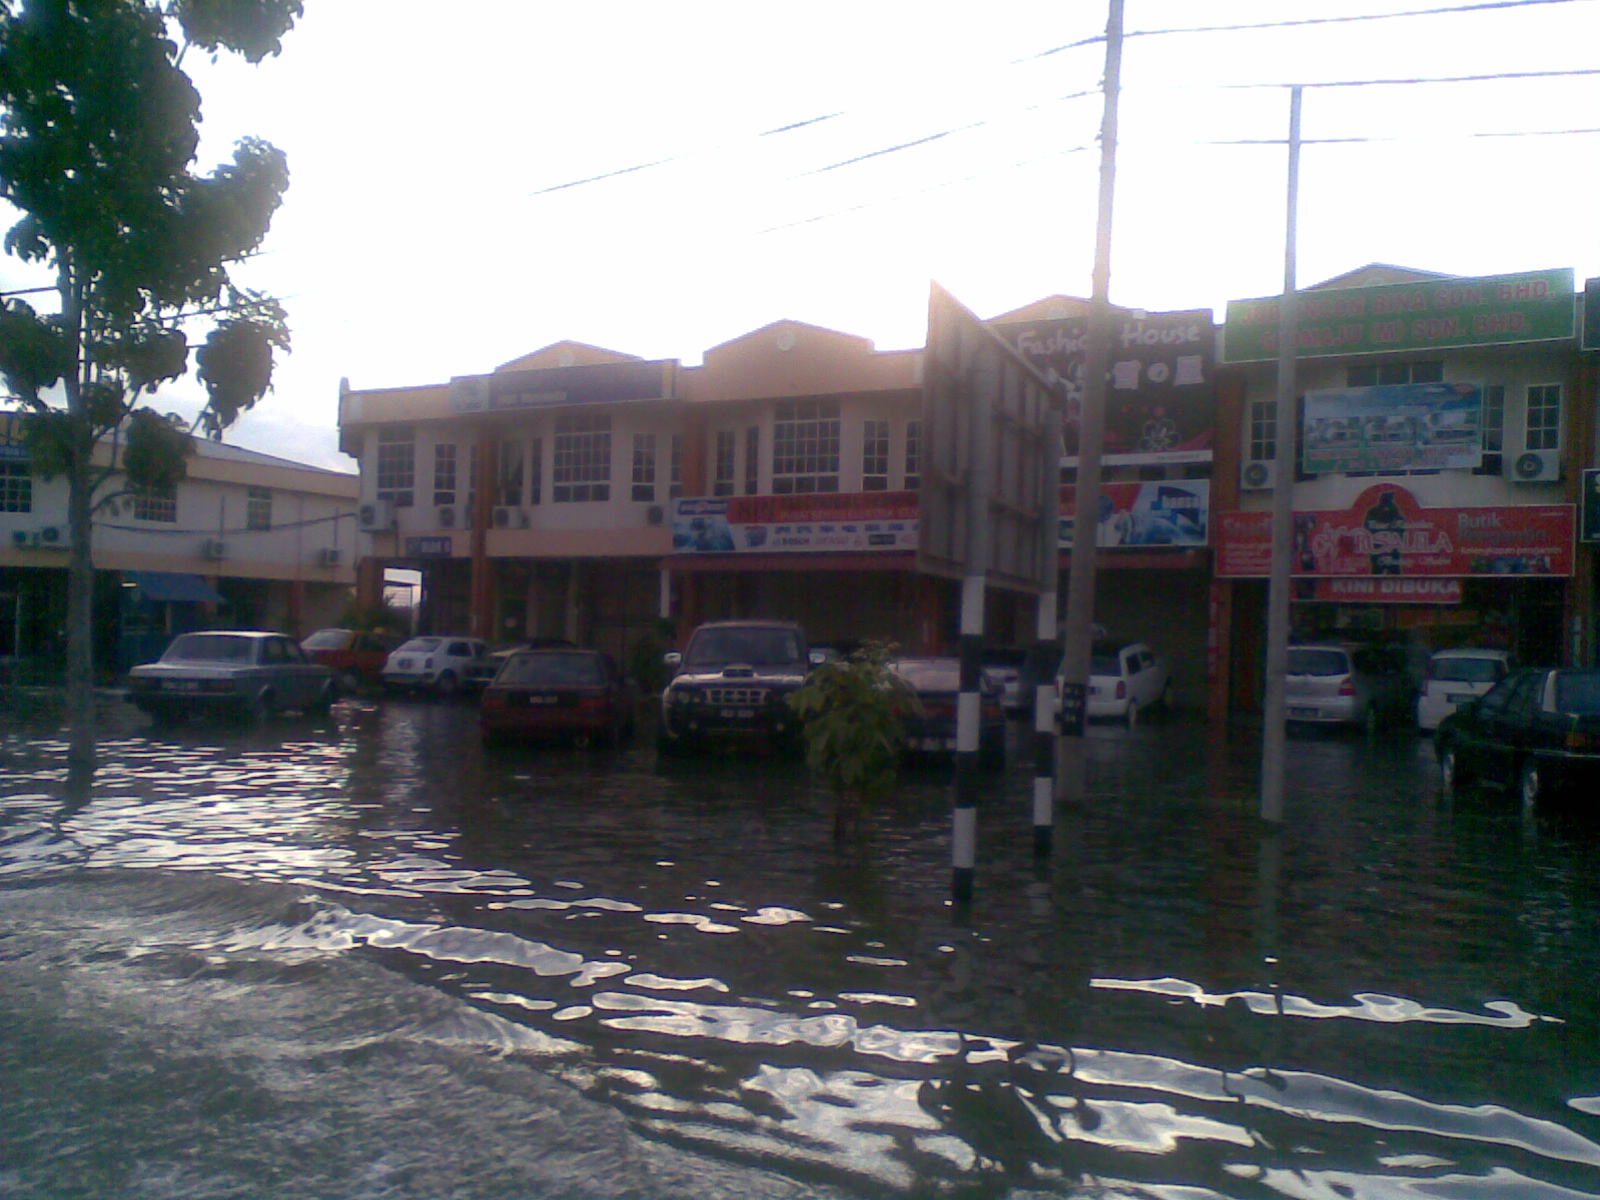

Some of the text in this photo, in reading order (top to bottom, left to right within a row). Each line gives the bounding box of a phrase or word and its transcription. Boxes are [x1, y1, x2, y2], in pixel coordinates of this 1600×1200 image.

[1121, 321, 1201, 349] House
[1458, 511, 1502, 529] Butik
[1332, 579, 1460, 593] KINI DIBUKA
